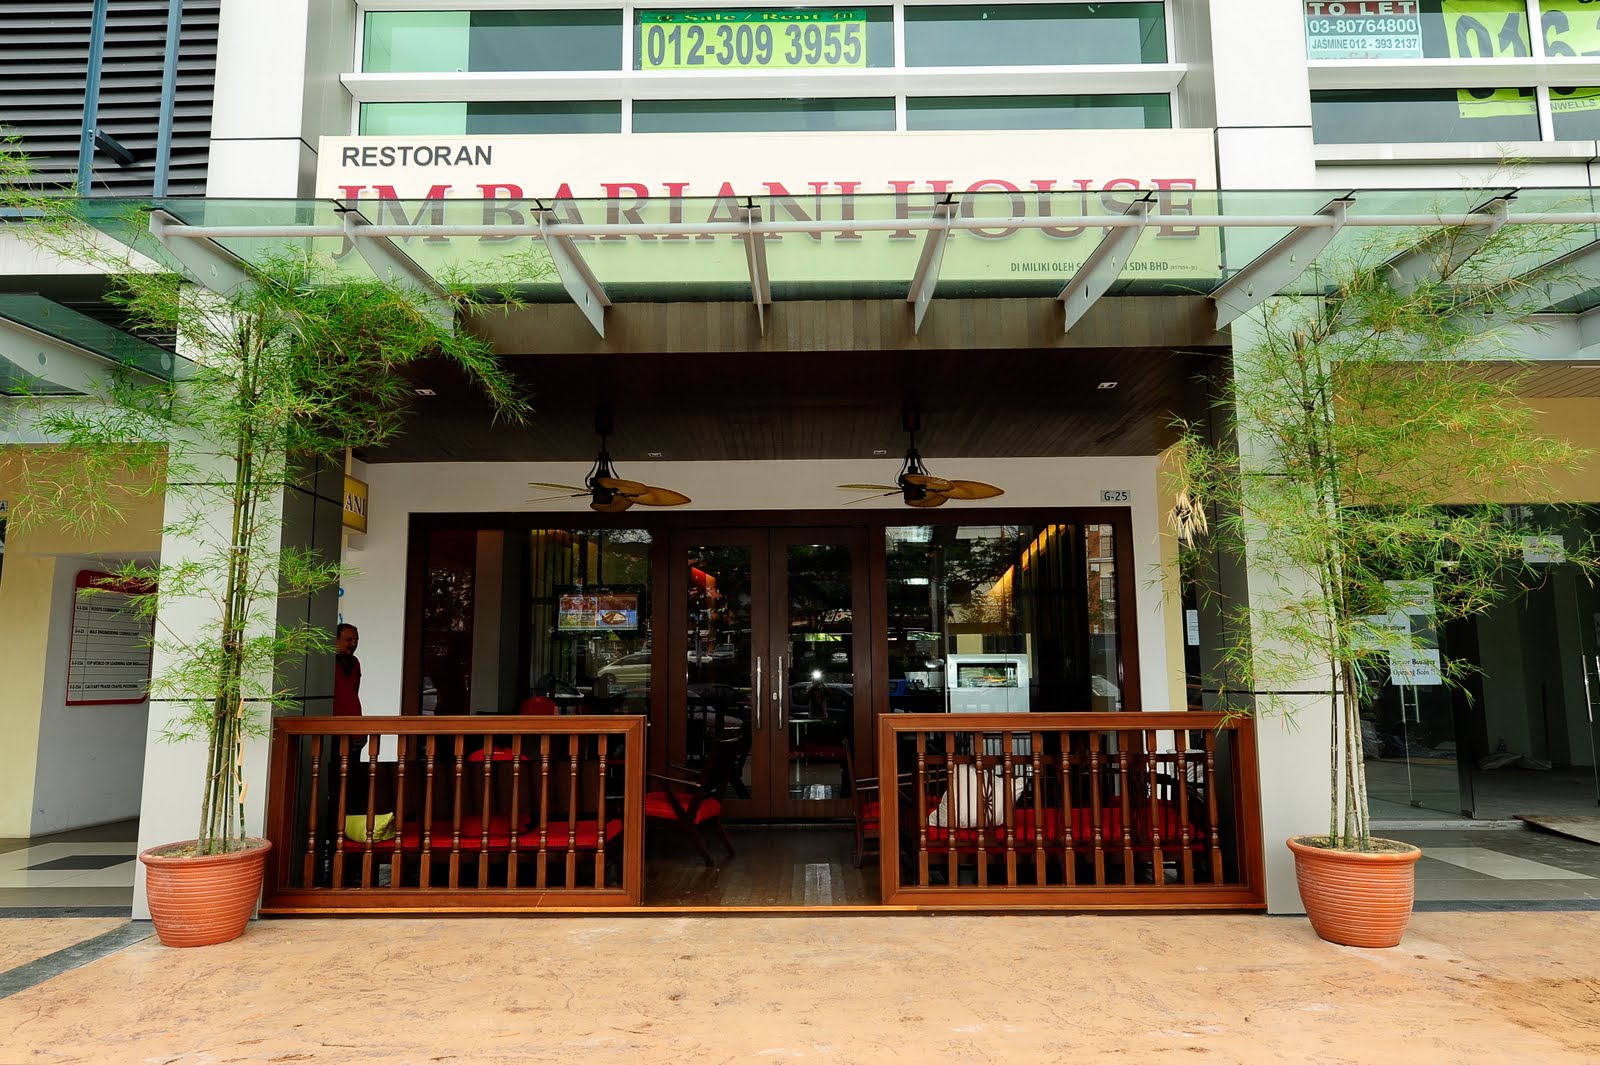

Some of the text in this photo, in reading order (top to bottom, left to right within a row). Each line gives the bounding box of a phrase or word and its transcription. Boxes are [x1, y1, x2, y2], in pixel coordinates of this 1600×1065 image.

[1308, 1, 1415, 16] TO LET
[1309, 19, 1417, 34] 03-80764800
[647, 24, 861, 66] 012-309 3955
[1312, 39, 1348, 50] JASMINE
[1394, 38, 1417, 49] 2137
[341, 145, 493, 167] RESTORAN
[332, 177, 1201, 261] JM BARIANI HOUSE
[1011, 263, 1020, 272] DI
[1022, 262, 1050, 272] MILIKI
[1052, 262, 1074, 272] OLEH
[1130, 263, 1148, 271] SDN
[1150, 262, 1169, 271] BHD
[1103, 491, 1128, 501] G-25
